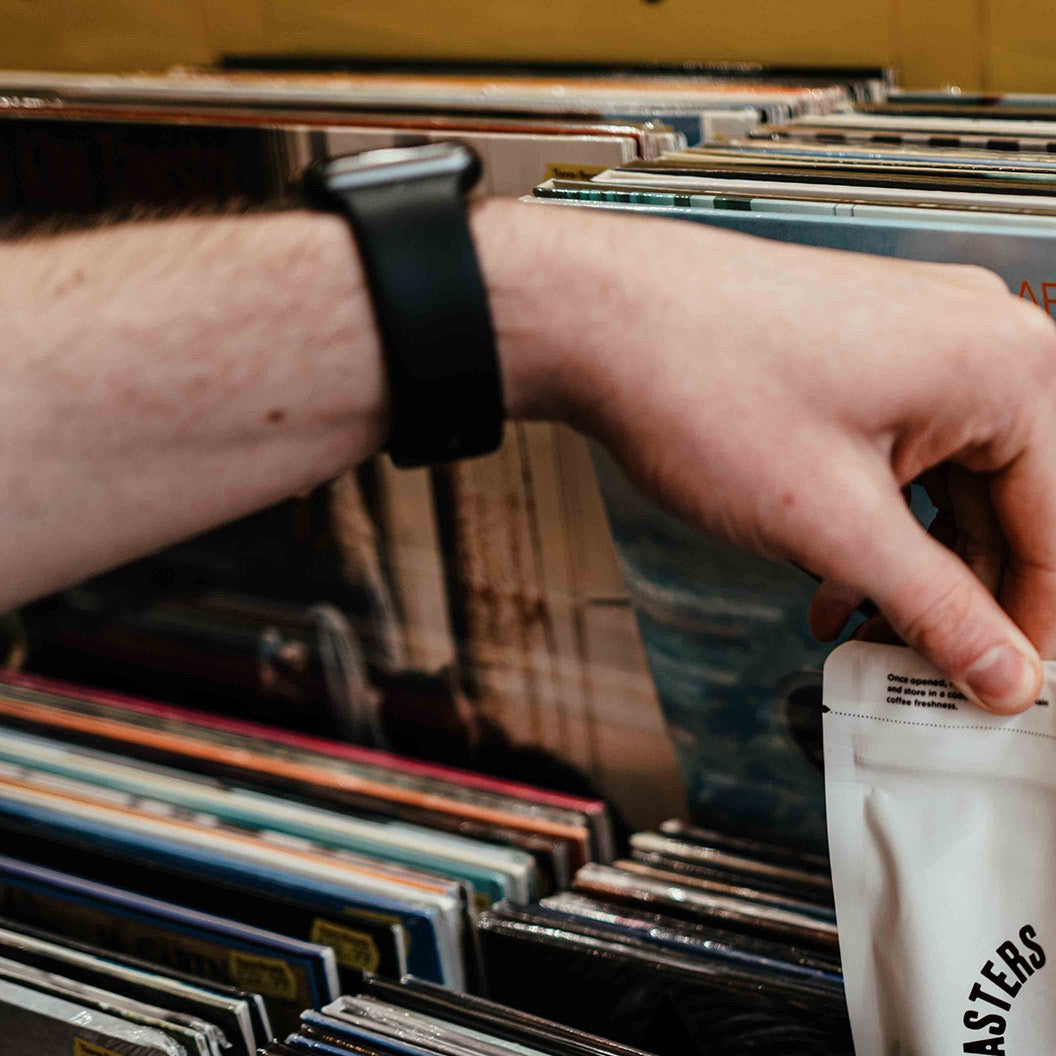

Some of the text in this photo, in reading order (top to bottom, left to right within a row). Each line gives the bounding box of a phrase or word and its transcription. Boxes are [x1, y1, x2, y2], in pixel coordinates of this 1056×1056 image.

[887, 673, 909, 684] Once
[910, 677, 947, 688] opened,
[887, 686, 902, 694] and
[904, 687, 926, 697] store
[928, 689, 937, 697] in
[886, 696, 958, 710] coffee freshness.
